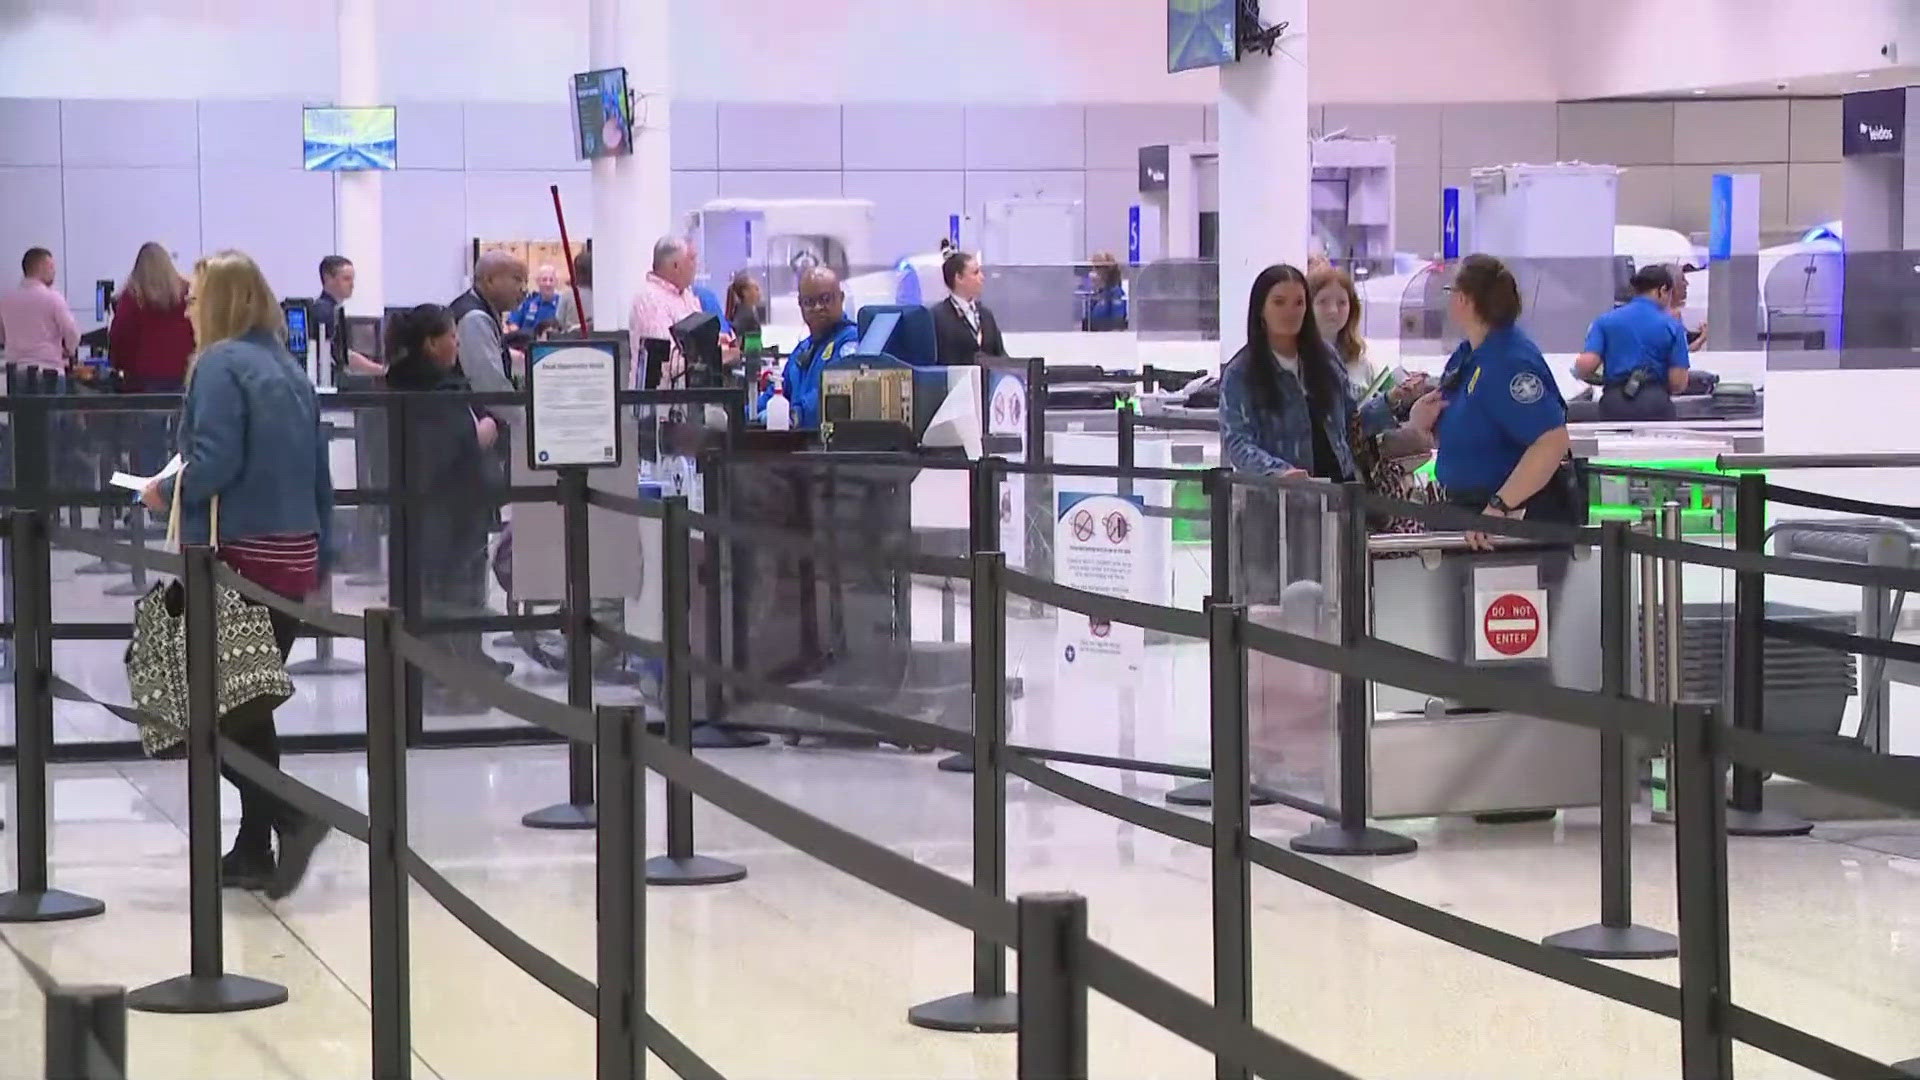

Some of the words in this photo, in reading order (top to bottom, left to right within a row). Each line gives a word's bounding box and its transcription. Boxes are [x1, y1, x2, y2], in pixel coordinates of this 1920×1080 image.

[1446, 208, 1455, 242] 4
[1131, 222, 1138, 251] 5
[1492, 607, 1505, 617] DO
[1513, 606, 1531, 617] NOT
[1496, 633, 1527, 645] ENTER
